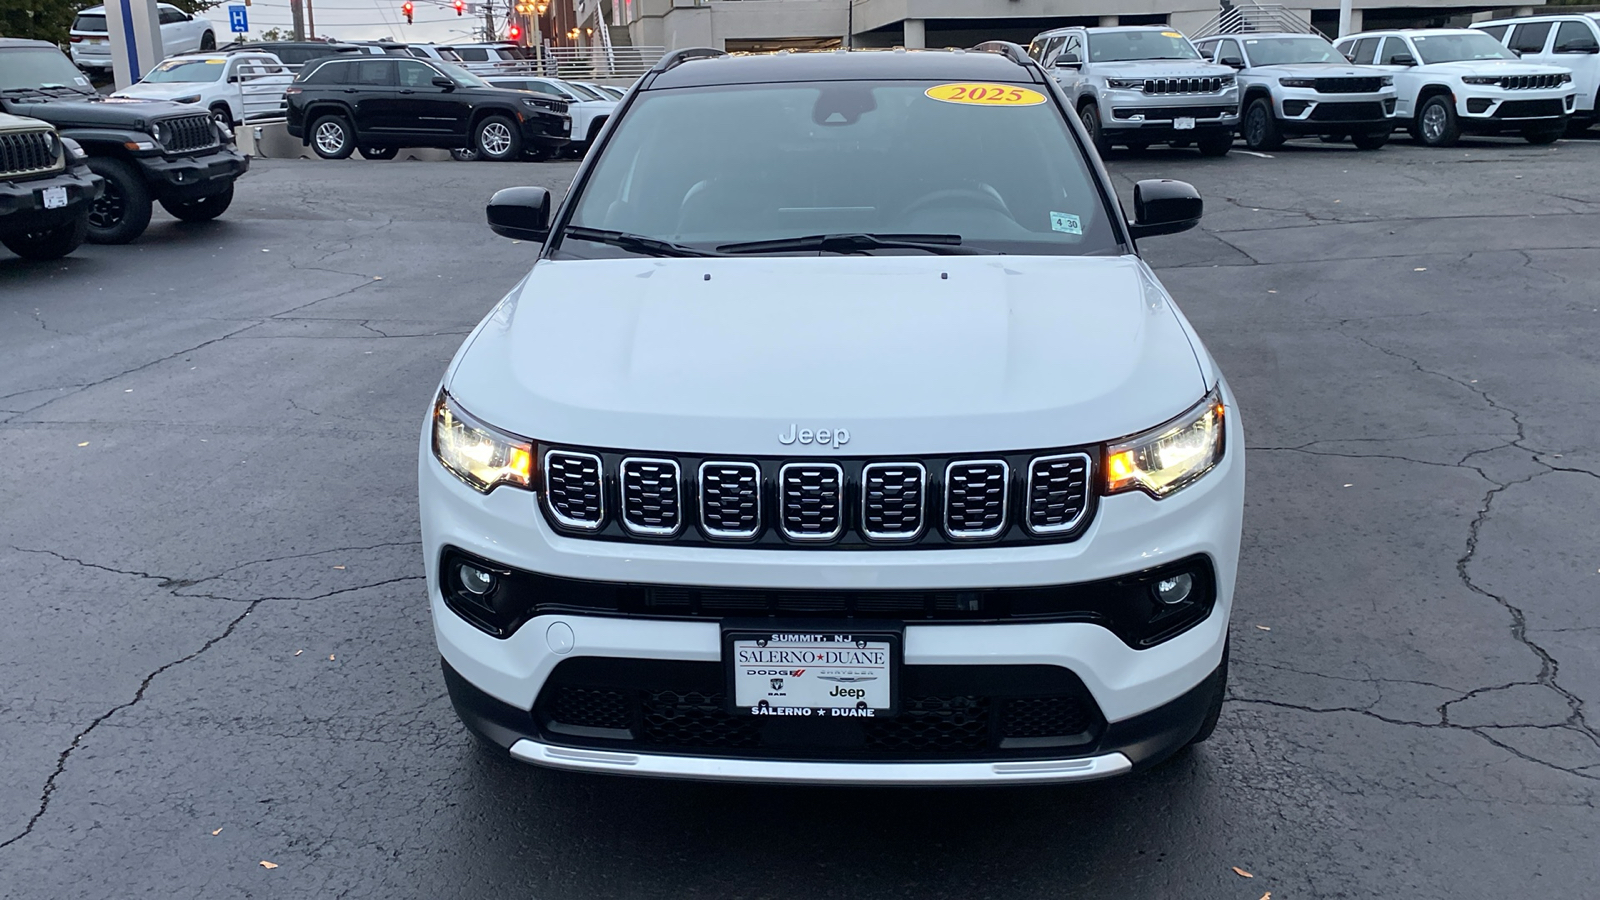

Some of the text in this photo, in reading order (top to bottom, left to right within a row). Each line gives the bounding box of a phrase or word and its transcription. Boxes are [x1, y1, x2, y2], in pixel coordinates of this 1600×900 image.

[233, 12, 244, 24] H
[948, 87, 1024, 102] 2025
[1056, 218, 1078, 229] 4 30
[778, 423, 851, 449] Jeep
[771, 634, 852, 643] SUMMIT, NJ
[739, 650, 885, 665] SALERNO DUANE
[829, 685, 865, 699] Jeep
[751, 706, 875, 717] SALERNO DUANE
